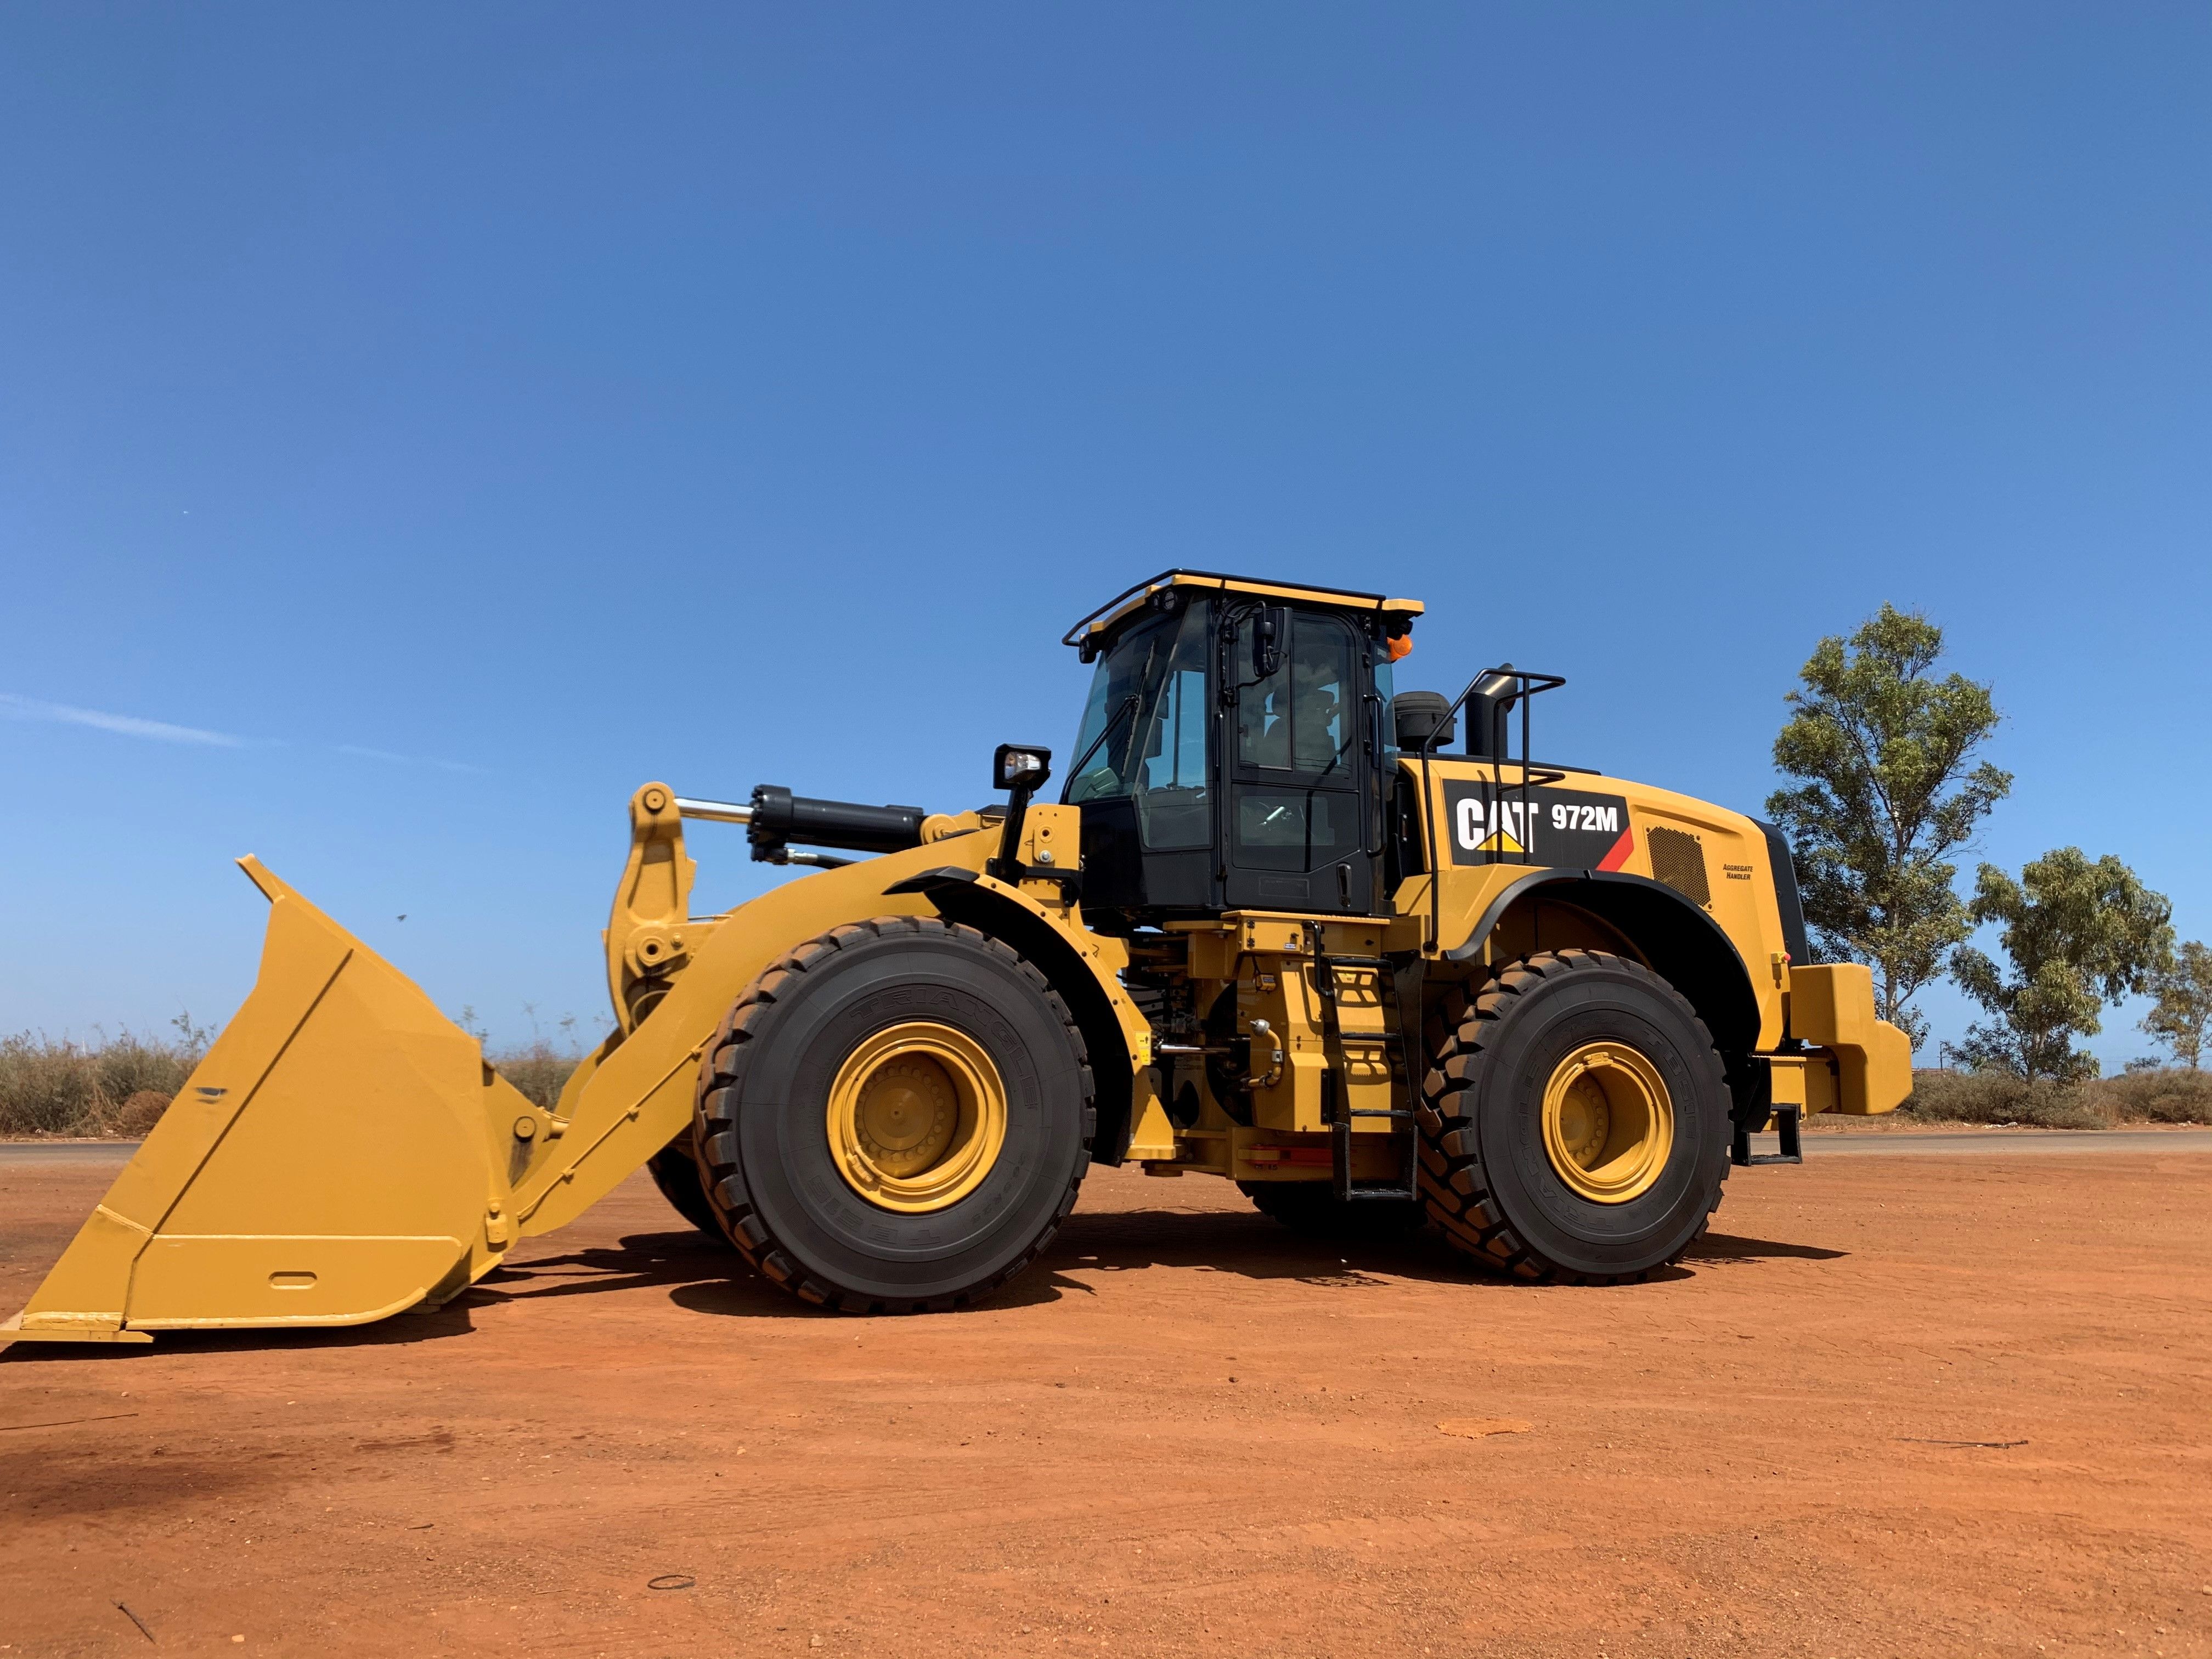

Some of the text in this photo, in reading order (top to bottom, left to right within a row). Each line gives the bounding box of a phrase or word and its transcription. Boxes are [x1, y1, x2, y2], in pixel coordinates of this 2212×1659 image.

[1457, 798, 1618, 853] CAT 972M
[1723, 864, 1753, 872] AGGREGATE
[1726, 872, 1751, 880] HANDLER
[850, 988, 1039, 1111] TRIANGLE
[1519, 1062, 1615, 1231] TRIANGLE
